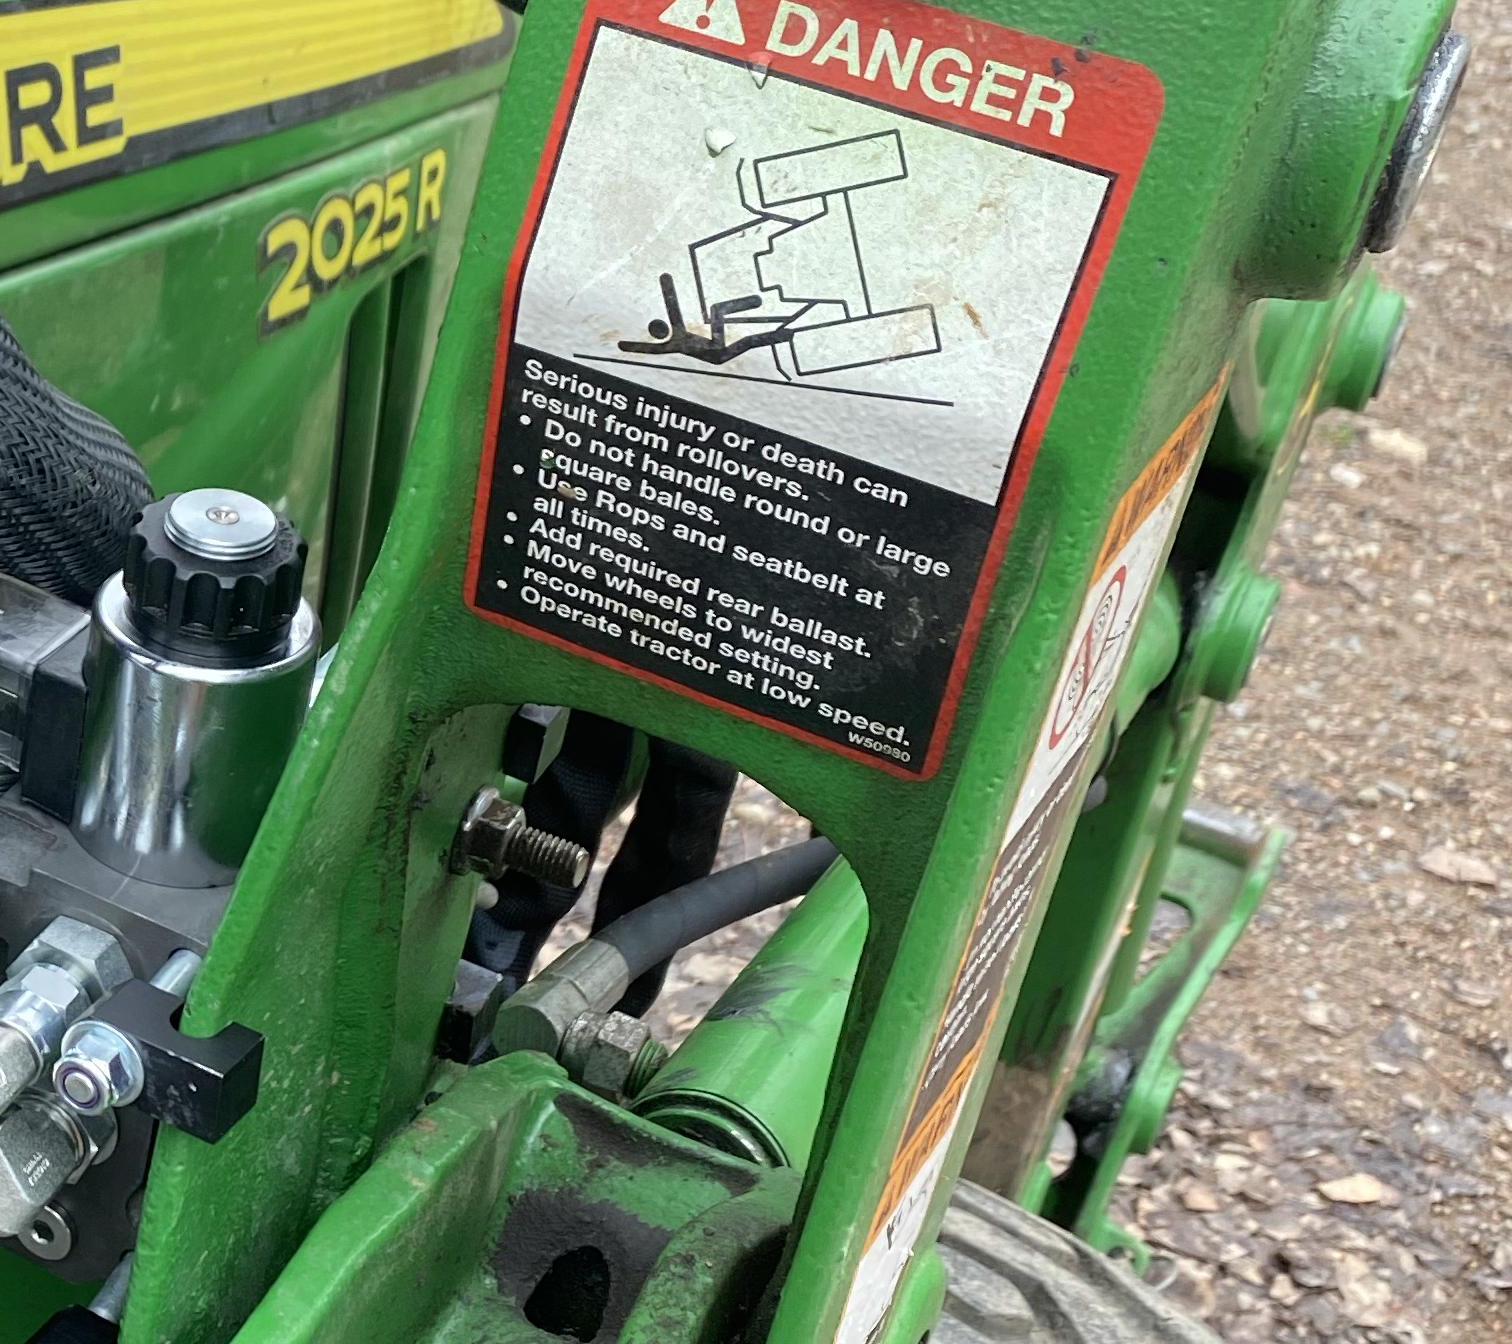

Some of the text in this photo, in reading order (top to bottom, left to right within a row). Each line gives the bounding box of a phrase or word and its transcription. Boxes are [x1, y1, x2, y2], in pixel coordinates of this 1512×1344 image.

[764, 0, 1076, 138] DANGER
[520, 387, 810, 503] result from rollovers.
[523, 357, 910, 509] Serious injury or death can
[543, 417, 952, 579] Do not handle round or large
[532, 495, 651, 554] all times.
[593, 488, 667, 532] Rops
[671, 522, 728, 555] and
[731, 544, 851, 598] seatbelt
[853, 587, 887, 611] at
[638, 478, 721, 527] bales.
[522, 564, 821, 691] recommended setting.
[526, 538, 836, 671] Move wheels to widest
[528, 516, 872, 660] Add required rear ballast.
[519, 584, 911, 748] Operate tractor at low speed.
